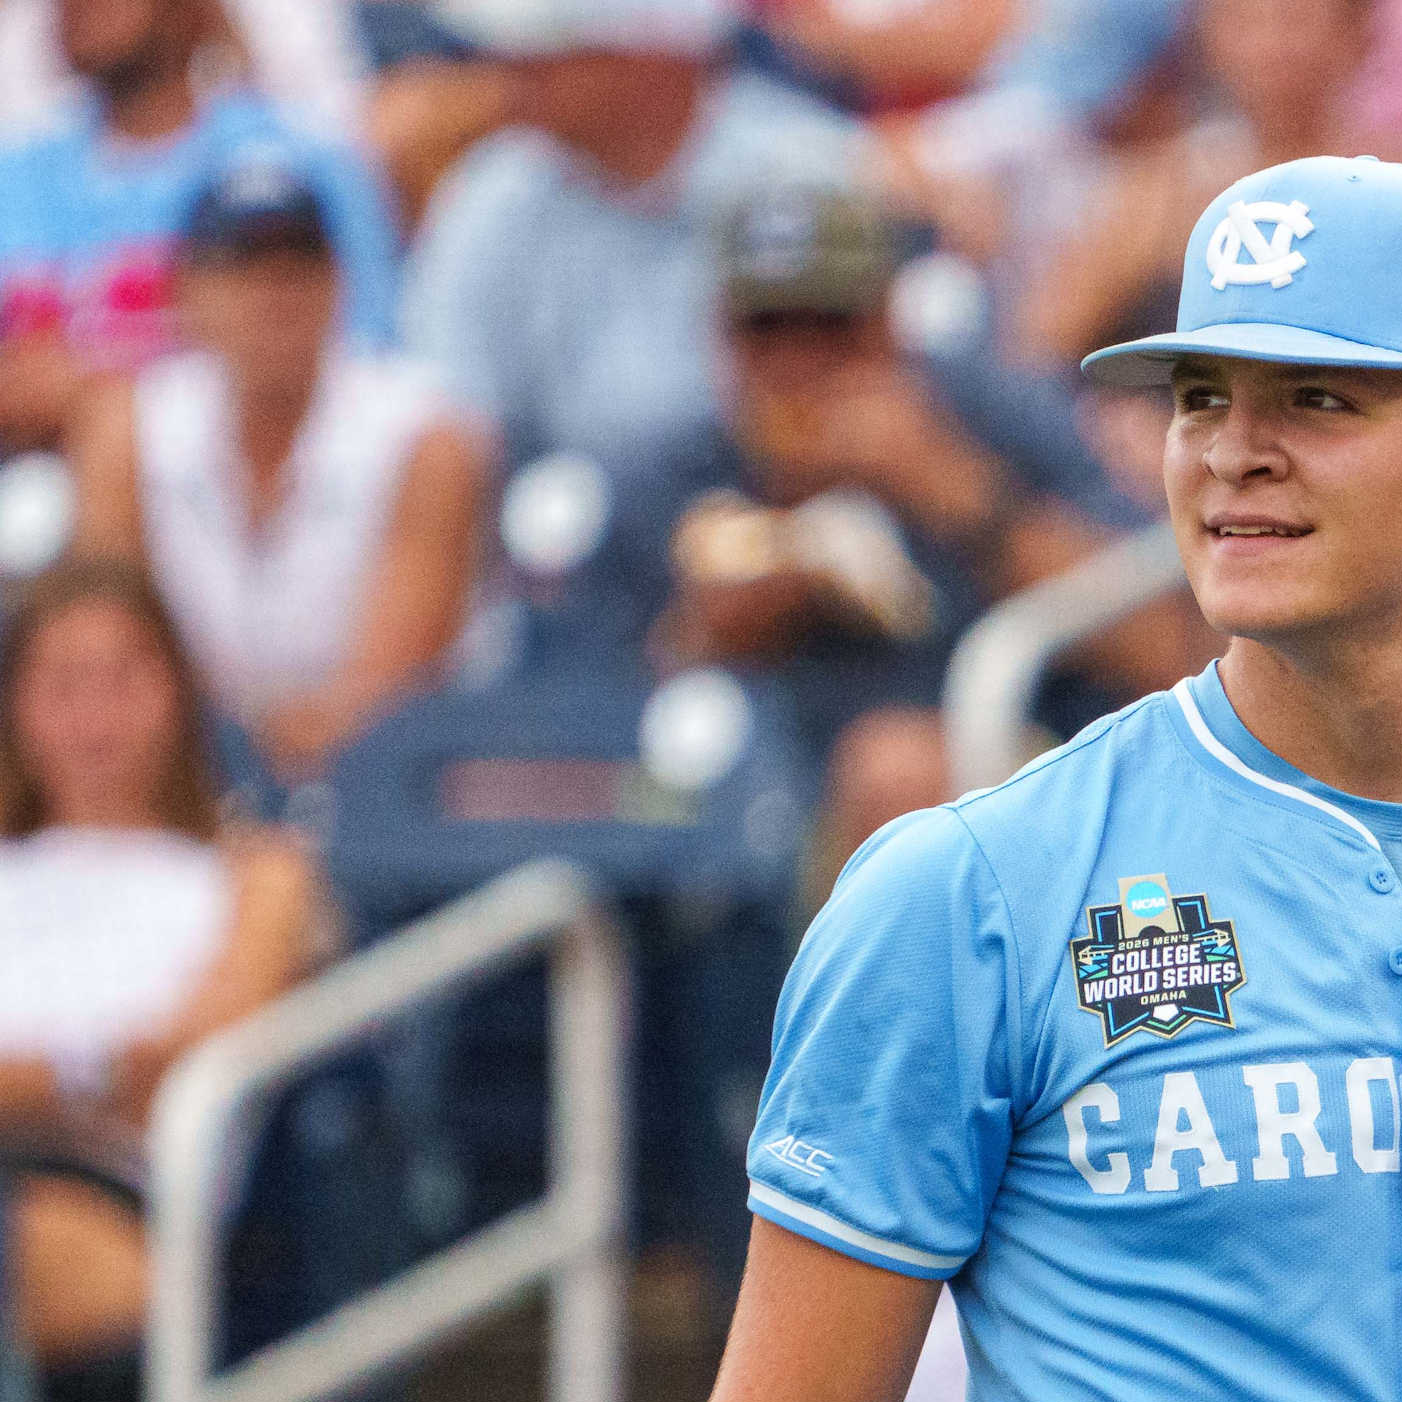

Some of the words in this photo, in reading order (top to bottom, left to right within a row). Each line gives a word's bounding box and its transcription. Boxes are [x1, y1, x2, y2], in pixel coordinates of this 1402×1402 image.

[1132, 896, 1167, 911] NCAA
[1118, 938, 1150, 951] 2026
[1152, 934, 1190, 945] MEN'S
[1111, 943, 1202, 975] COLLEGE
[1083, 971, 1158, 1004] WORLD
[1162, 962, 1237, 989] SERIES
[1140, 990, 1187, 1005] OMAHA
[763, 1135, 834, 1177] ACC
